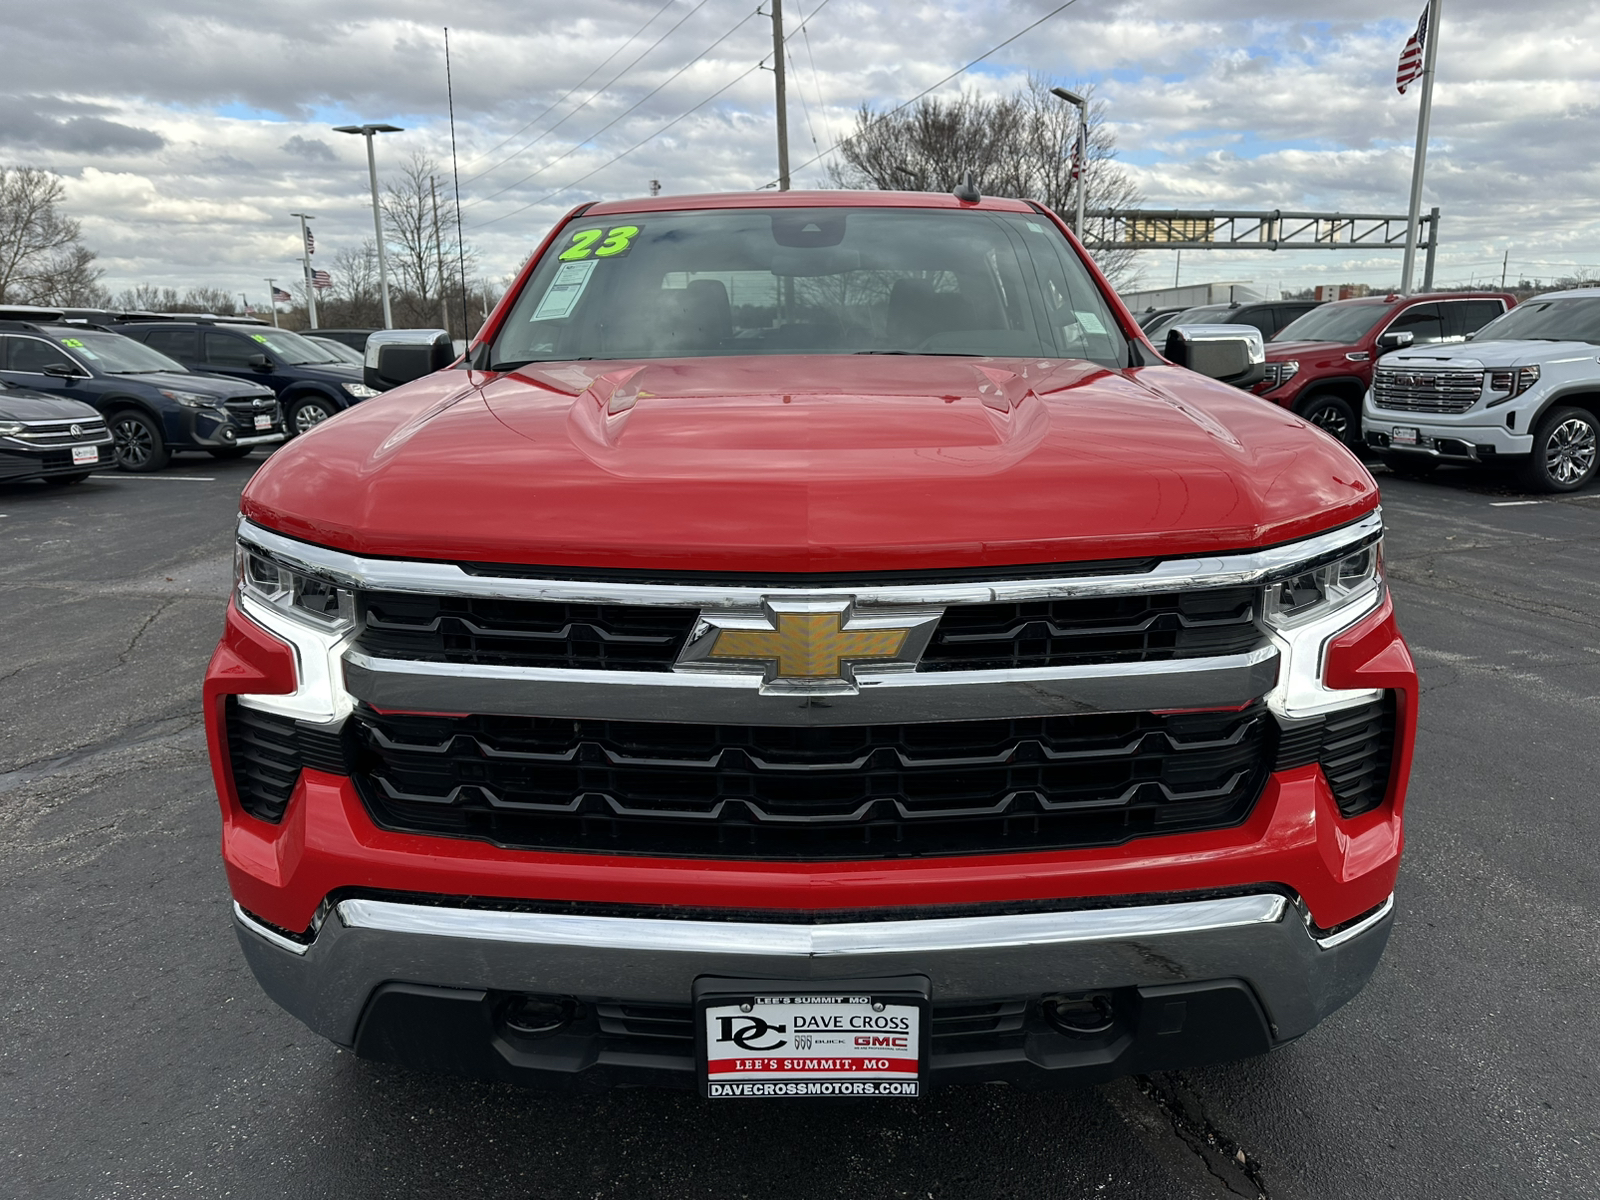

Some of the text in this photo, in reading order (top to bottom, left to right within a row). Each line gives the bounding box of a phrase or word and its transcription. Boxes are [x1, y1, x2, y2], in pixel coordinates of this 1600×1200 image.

[558, 225, 640, 261] 23
[61, 338, 83, 347] 23
[794, 1016, 910, 1030] DAVE CROSS
[715, 1015, 788, 1051] DC
[854, 1036, 908, 1047] GMC
[735, 1059, 890, 1071] LEE'S SUMMIT, MO
[711, 1083, 916, 1096] DAVECROSSMOTORS.COM
